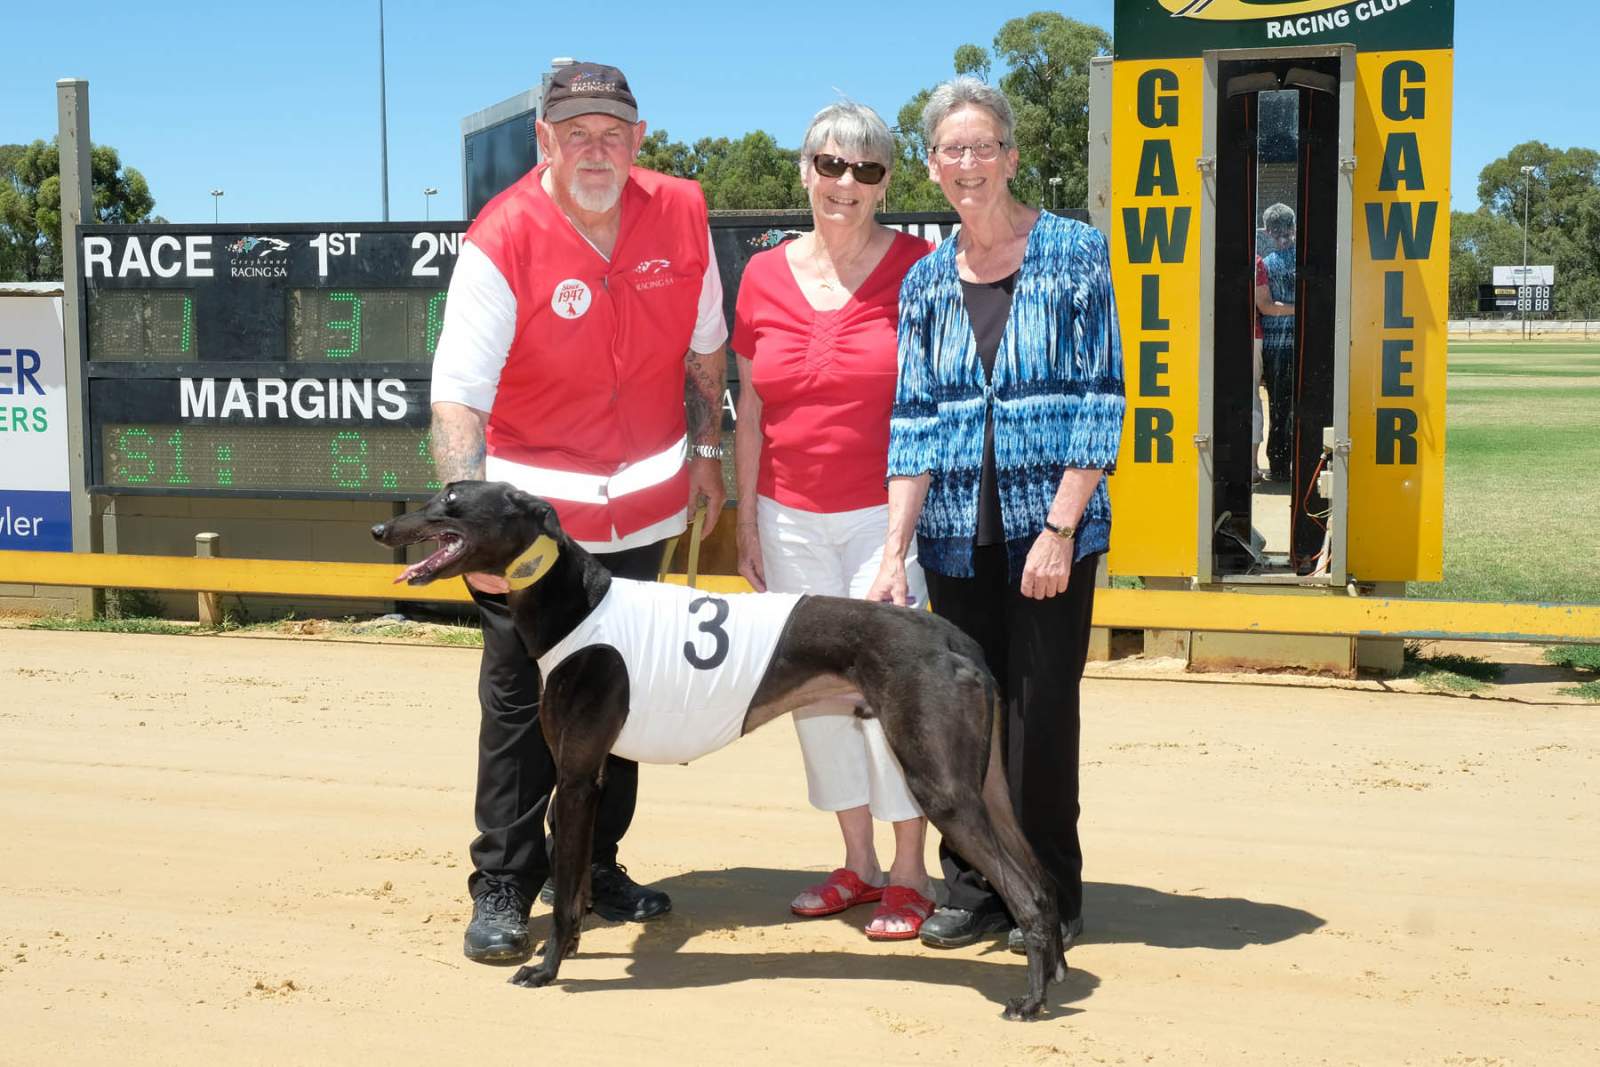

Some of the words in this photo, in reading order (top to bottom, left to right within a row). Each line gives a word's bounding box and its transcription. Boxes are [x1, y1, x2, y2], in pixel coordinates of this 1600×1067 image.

[1266, 9, 1350, 39] RACING
[1355, 0, 1411, 21] CLU
[83, 235, 215, 278] RACE
[231, 267, 272, 278] RACING
[274, 266, 287, 277] SA
[309, 232, 361, 276] 1ST
[1122, 68, 1192, 463] GAWLER
[1364, 60, 1439, 465] GAWLER
[558, 288, 585, 303] 1947
[325, 292, 361, 359] 3
[180, 378, 408, 420] MARGINS
[683, 595, 730, 670] 3
